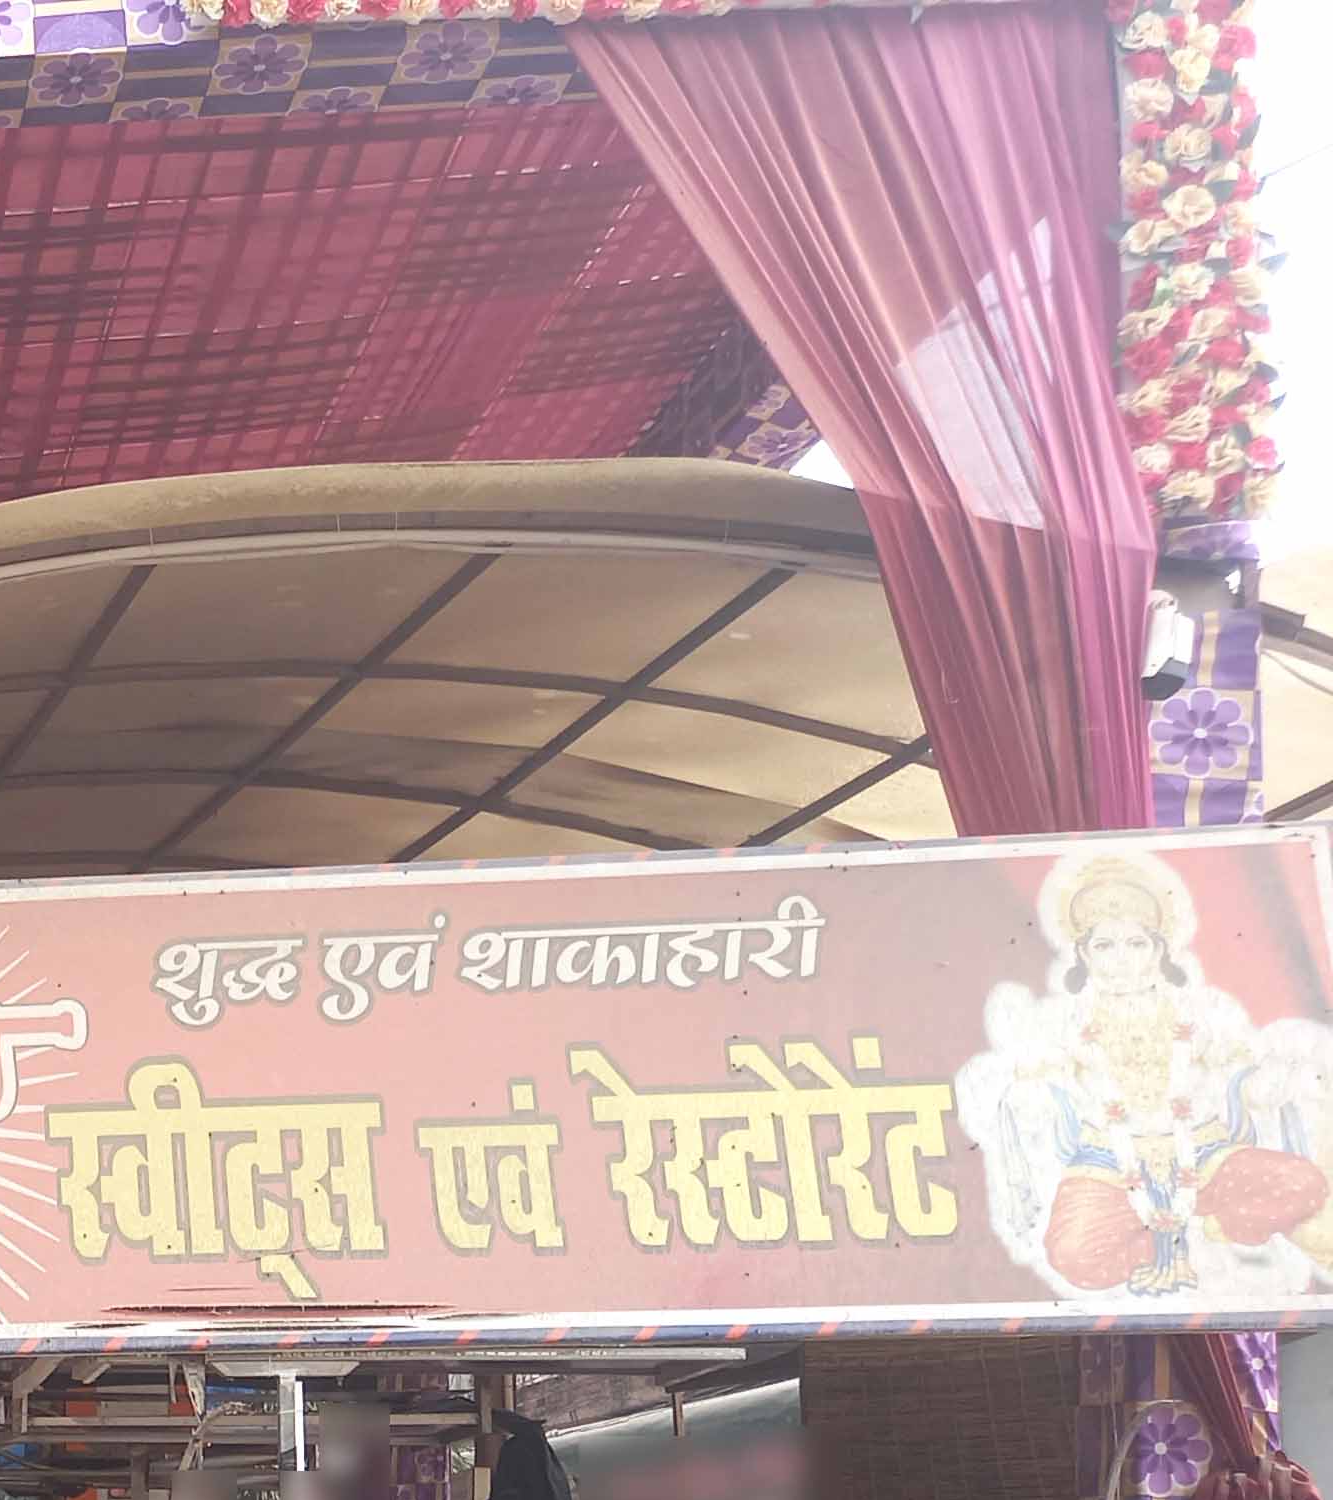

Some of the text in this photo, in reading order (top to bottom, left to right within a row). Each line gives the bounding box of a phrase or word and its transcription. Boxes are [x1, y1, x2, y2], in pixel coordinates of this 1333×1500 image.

[155, 894, 827, 1024] शुद्ध एवं शाकाहारी
[46, 1037, 959, 1300] स्वीट्स एवं रेस्टोरेंट
